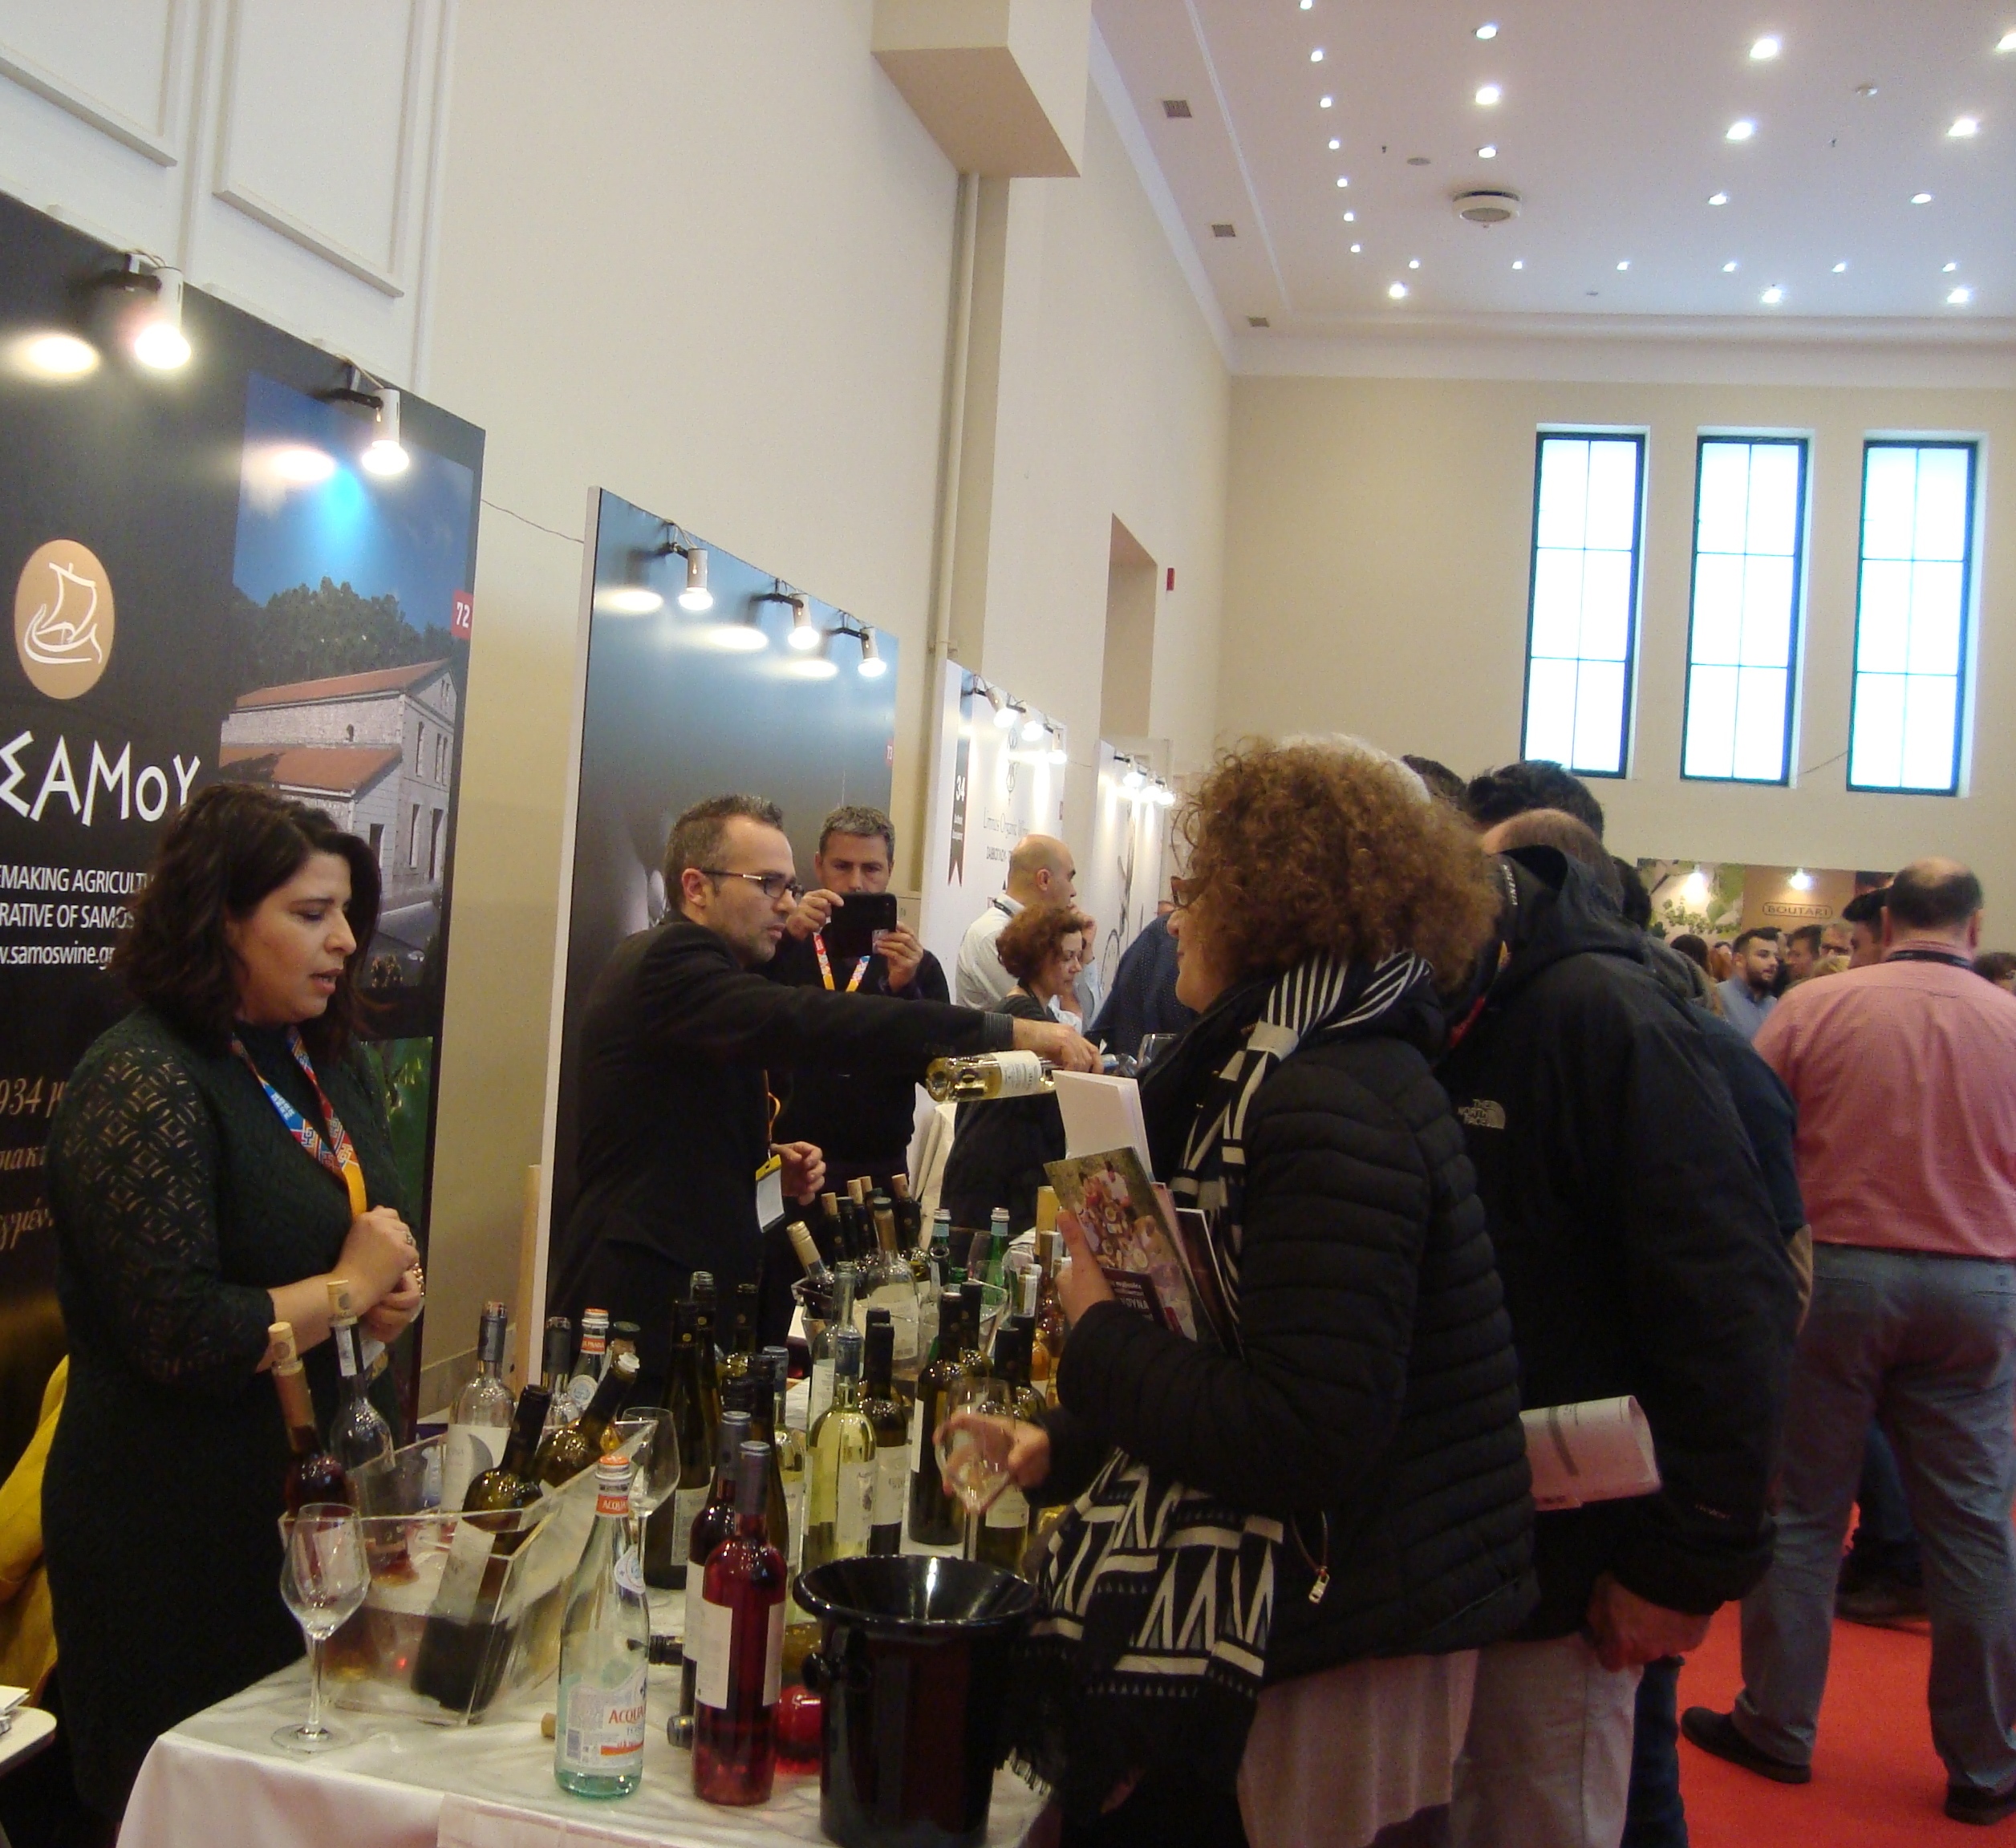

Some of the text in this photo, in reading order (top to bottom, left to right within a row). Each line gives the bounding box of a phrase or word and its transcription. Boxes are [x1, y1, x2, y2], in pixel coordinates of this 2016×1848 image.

[456, 602, 471, 629] 72
[955, 775, 966, 802] 34
[72, 869, 154, 895] AGRICULT
[57, 905, 79, 928] OF
[1768, 905, 1827, 916] BOUTARI
